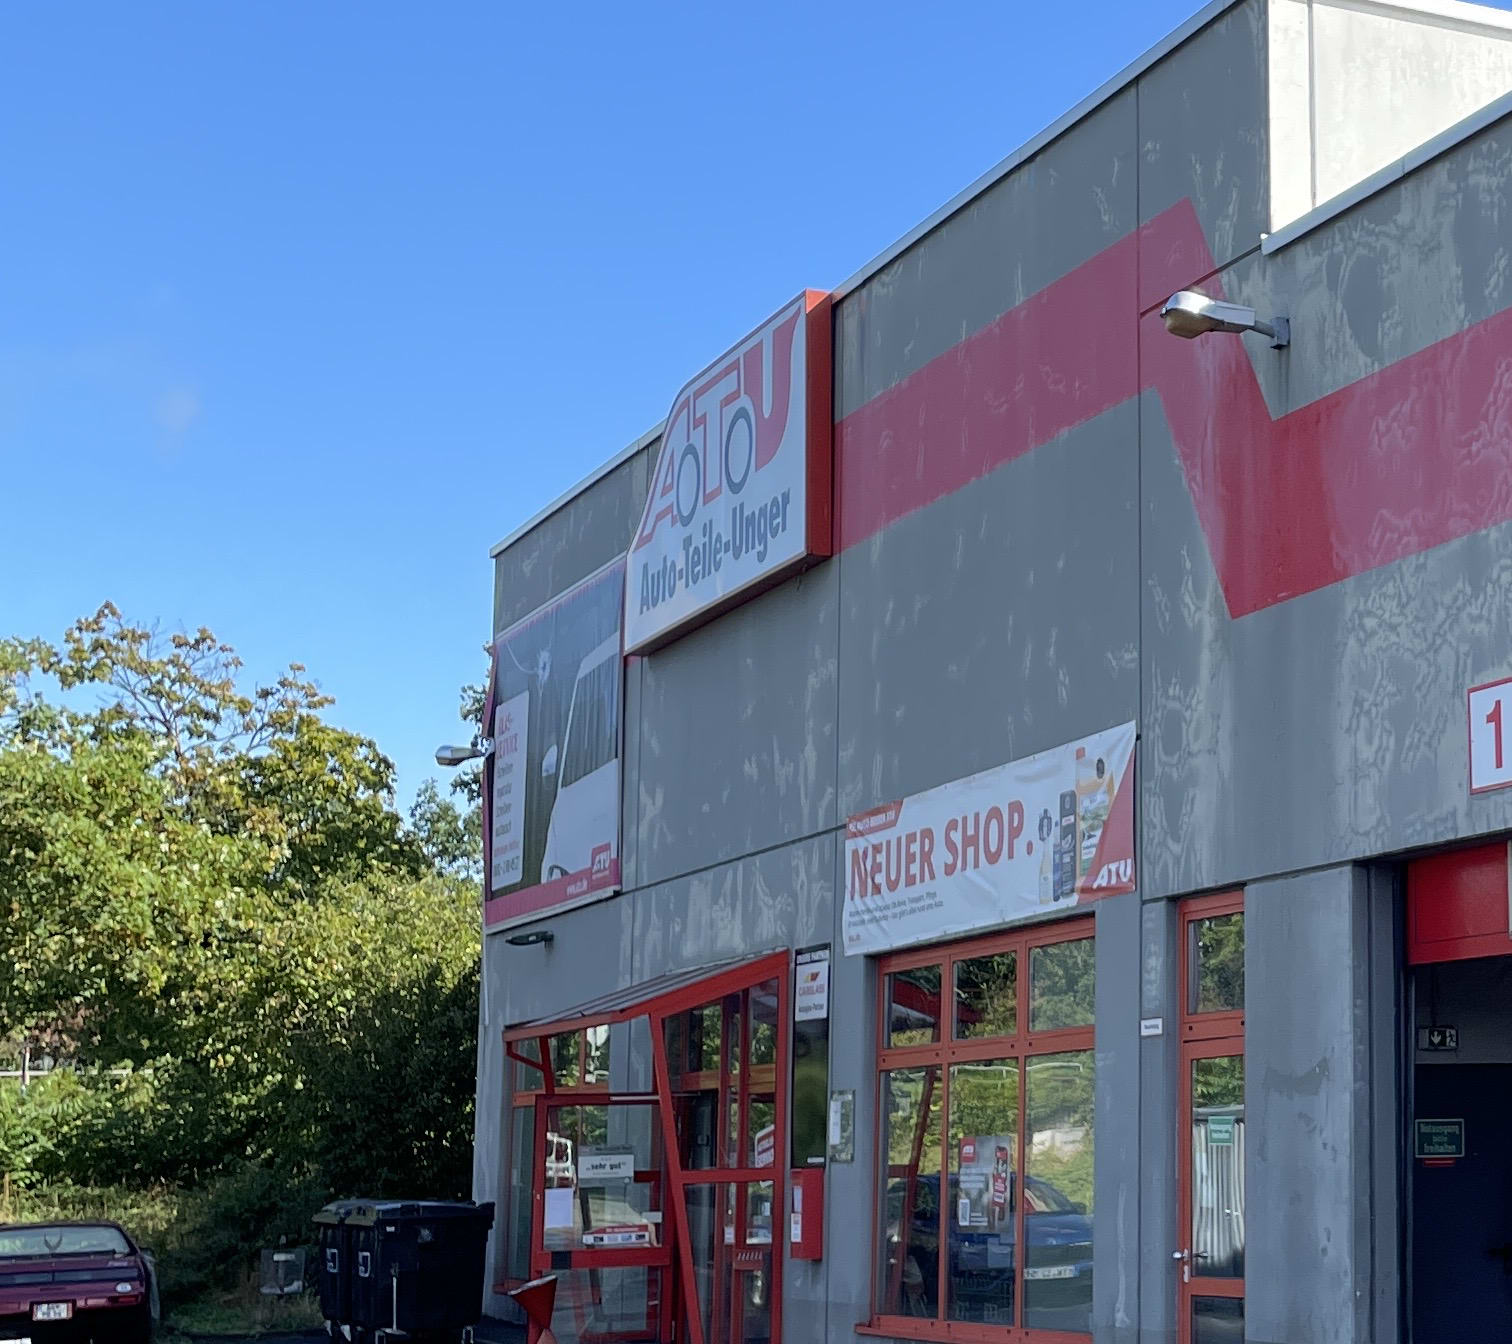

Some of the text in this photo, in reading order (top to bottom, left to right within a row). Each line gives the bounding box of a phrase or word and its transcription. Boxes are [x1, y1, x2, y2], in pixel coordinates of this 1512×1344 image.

[633, 305, 801, 552] ATU
[639, 488, 791, 615] Auto-Teile-Unger
[1485, 698, 1504, 770] 1
[849, 799, 1034, 901] NEUER SHOP.
[1092, 858, 1132, 889] ATU
